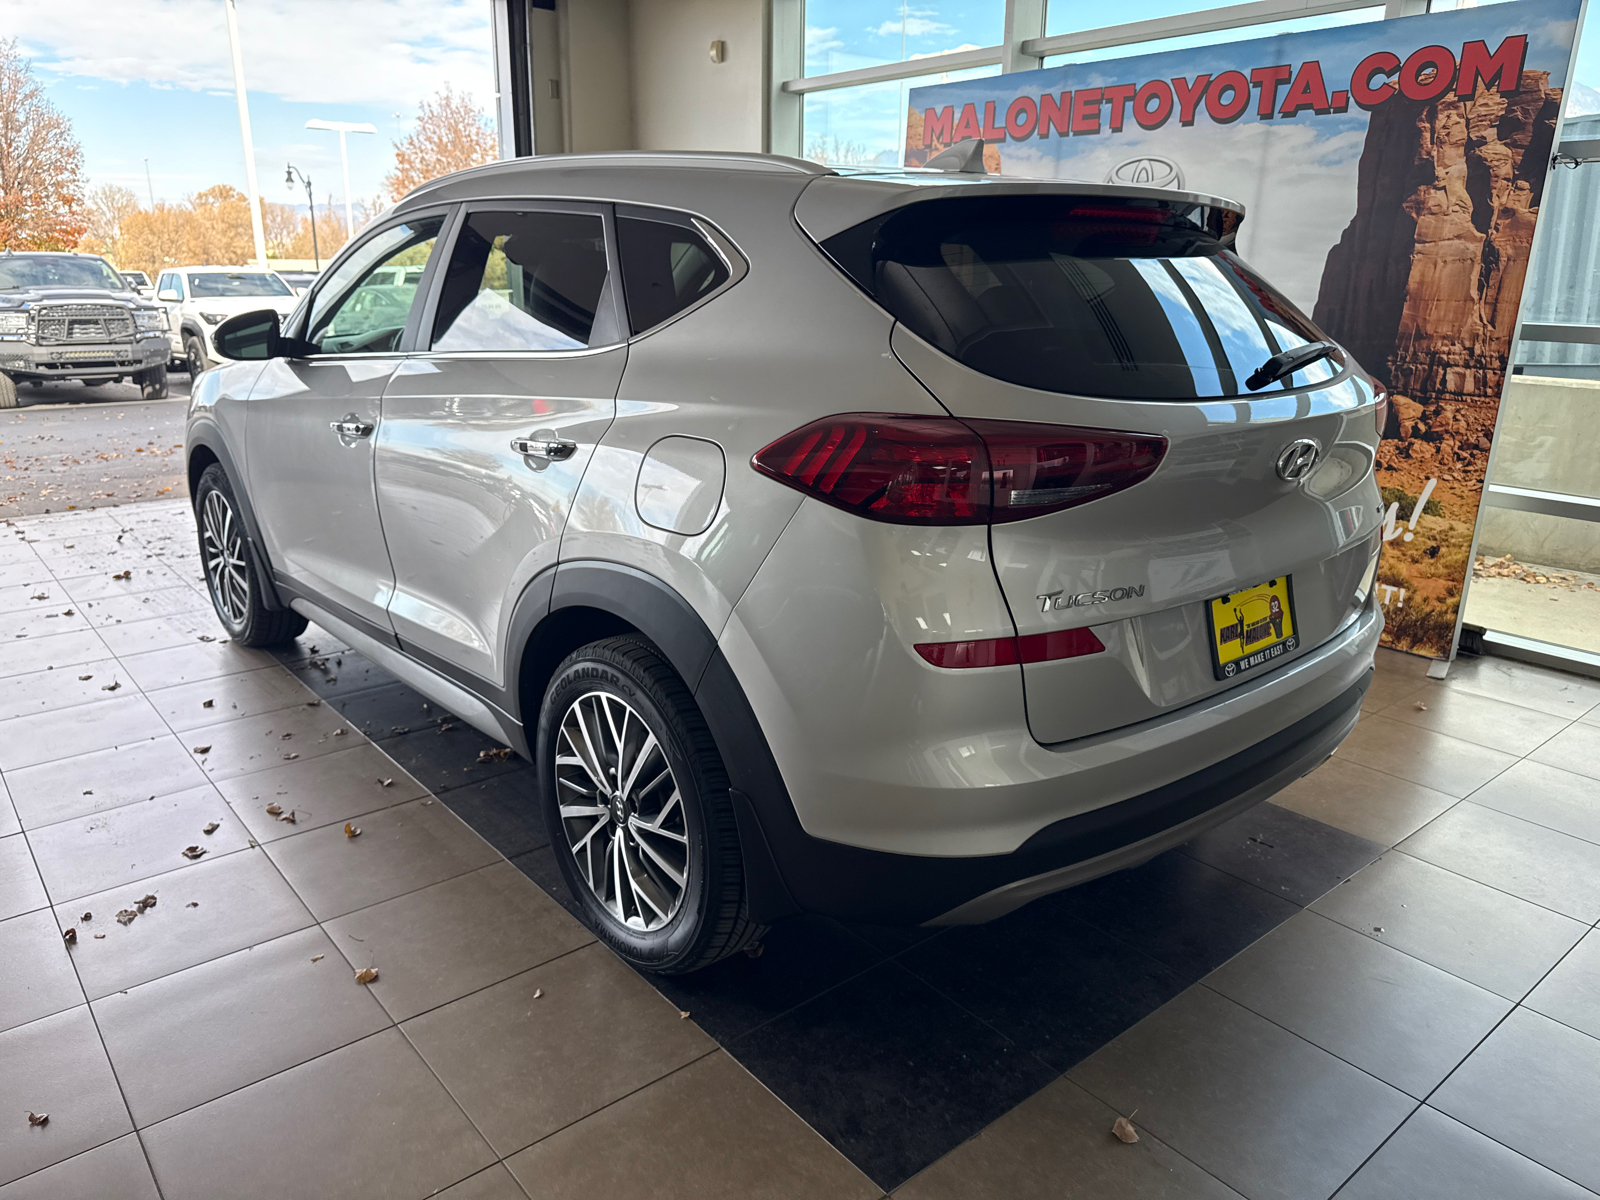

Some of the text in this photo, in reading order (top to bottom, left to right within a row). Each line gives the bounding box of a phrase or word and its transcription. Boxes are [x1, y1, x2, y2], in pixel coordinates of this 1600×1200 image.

[923, 34, 1529, 147] MALONETOYOTA.COM
[1036, 584, 1146, 613] TUCSON
[1271, 601, 1280, 613] 32
[1220, 622, 1240, 646] KARL
[1245, 621, 1272, 646] MALONE
[1240, 645, 1284, 670] WE MAKE IT EASY
[550, 667, 620, 705] GEOLANDAR
